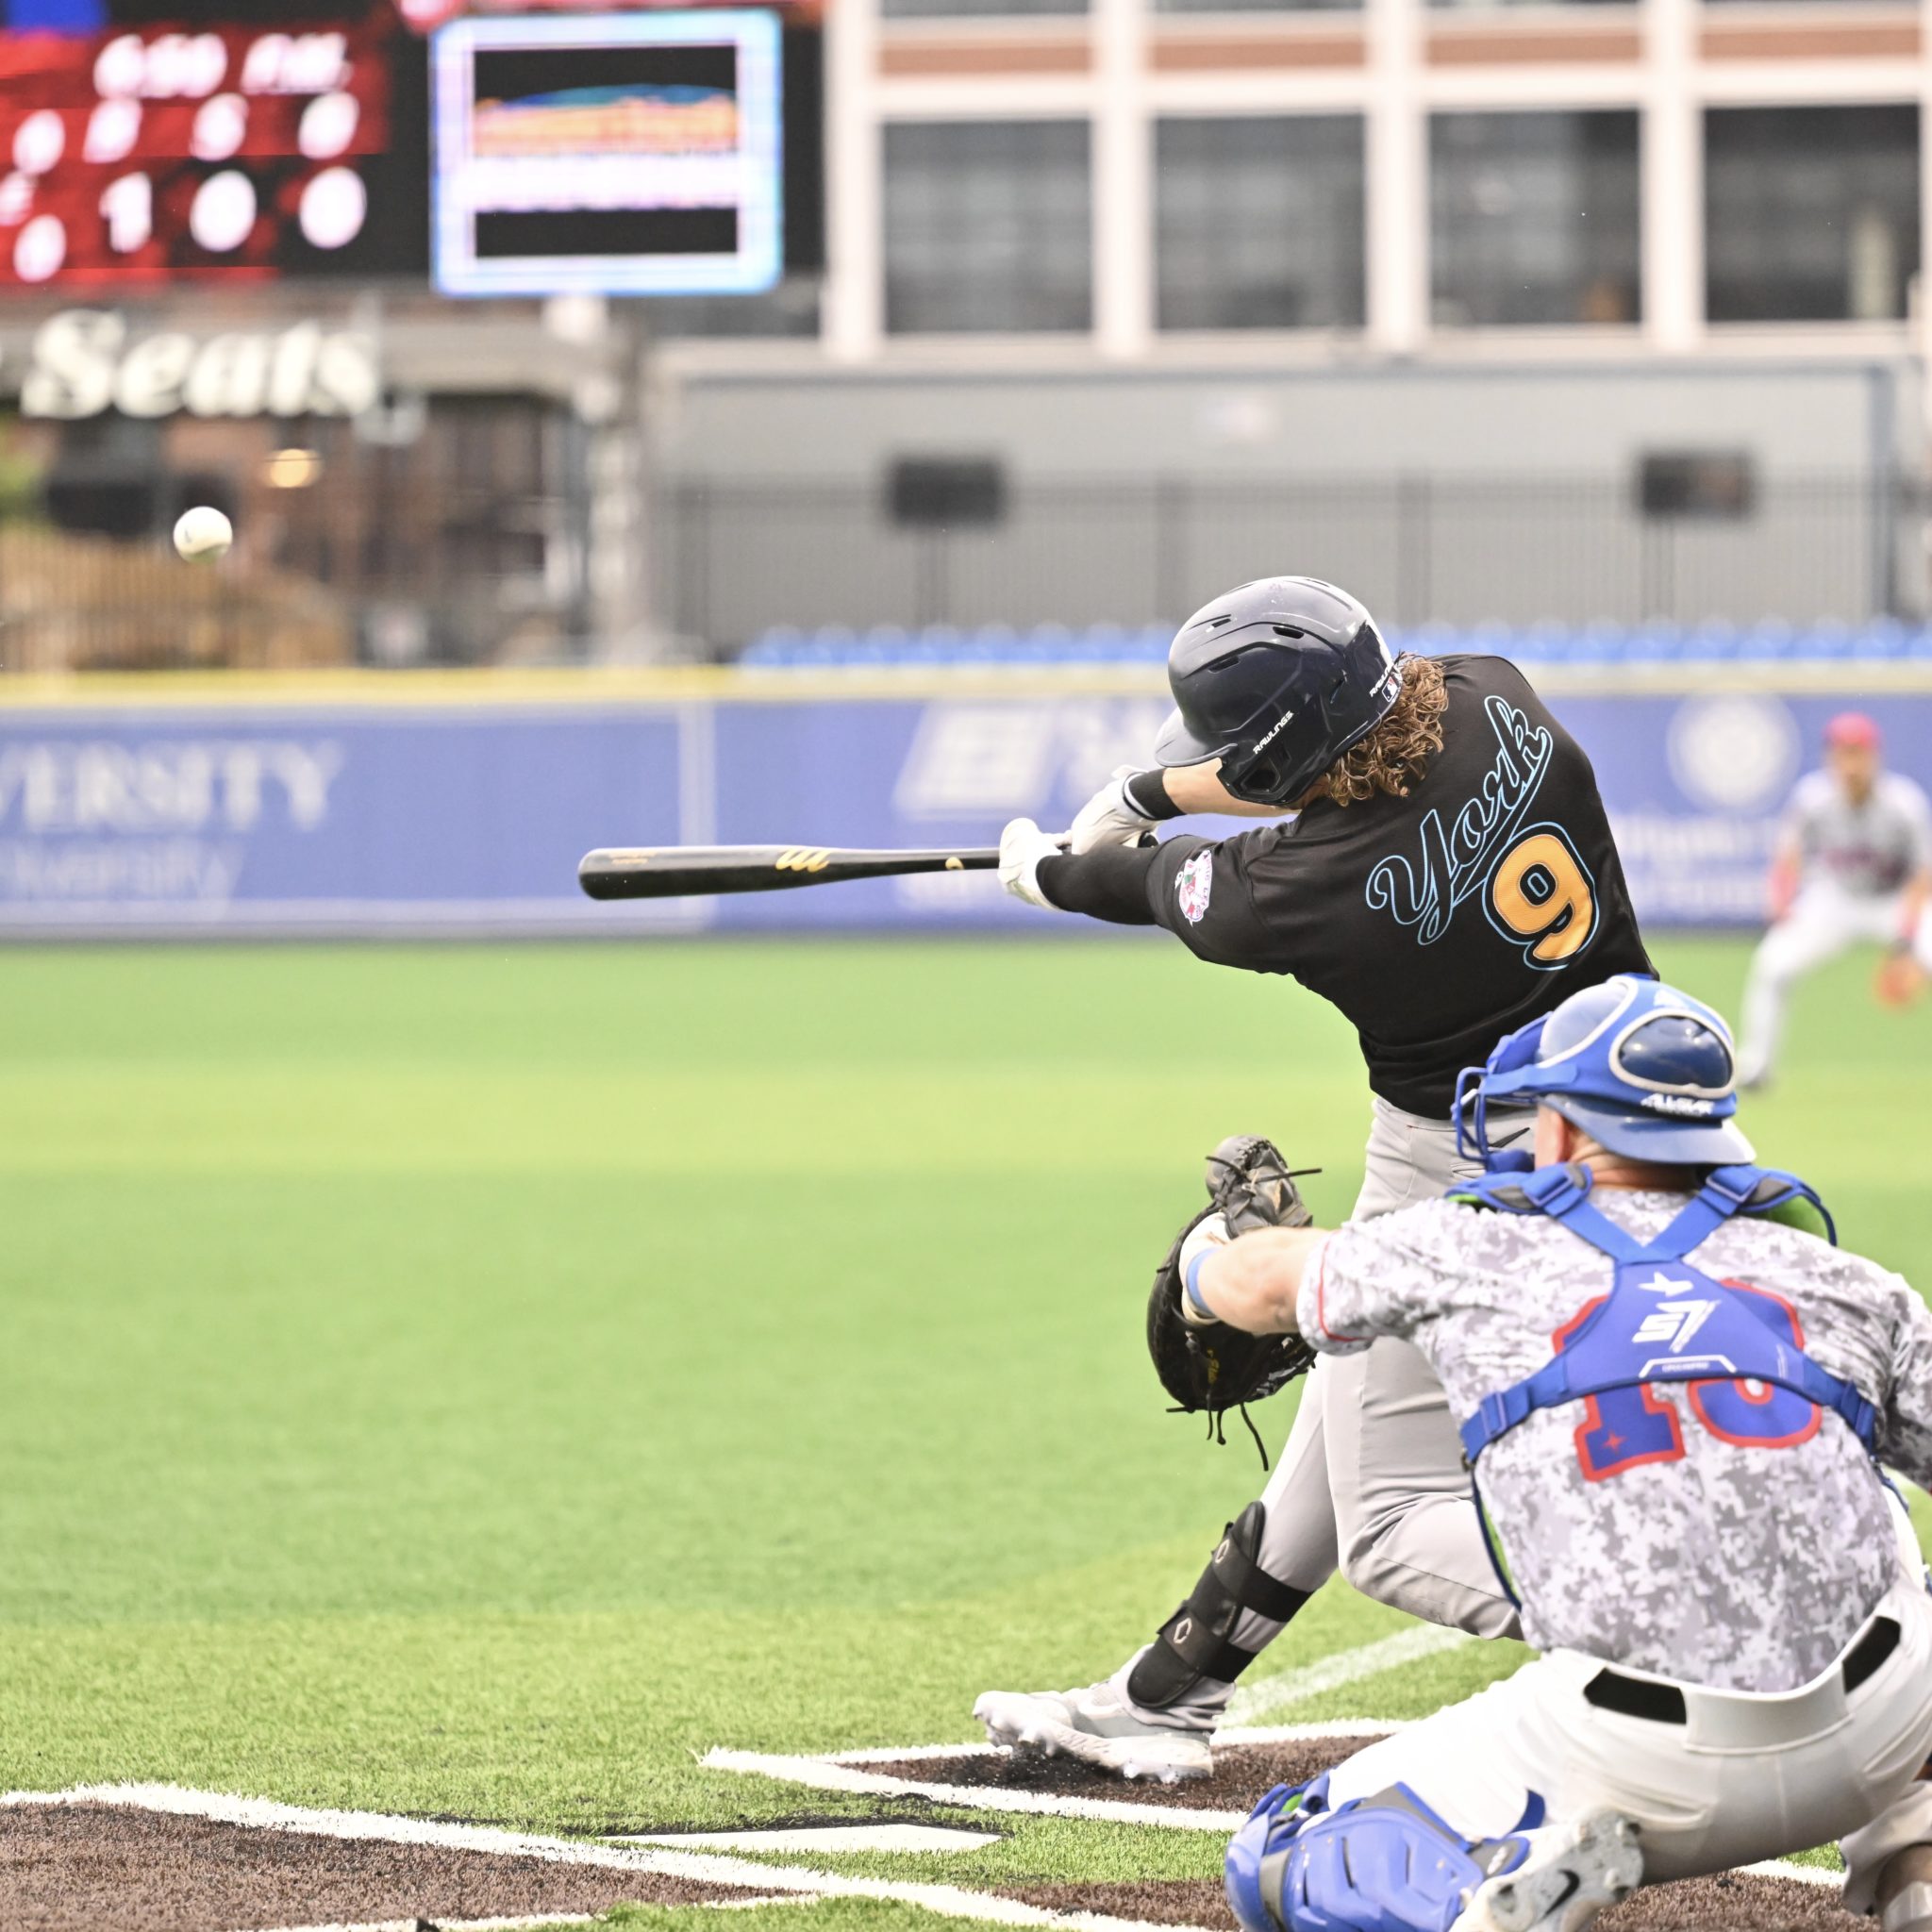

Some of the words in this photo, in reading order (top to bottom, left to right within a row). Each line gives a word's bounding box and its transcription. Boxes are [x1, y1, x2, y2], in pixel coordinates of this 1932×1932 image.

[99, 171, 153, 253] 1
[190, 169, 257, 252] 0
[299, 166, 368, 249] 0
[19, 308, 377, 420] Seats
[1252, 709, 1294, 755] RAWLINGS
[1365, 695, 1554, 945] York
[1482, 822, 1599, 970] 9
